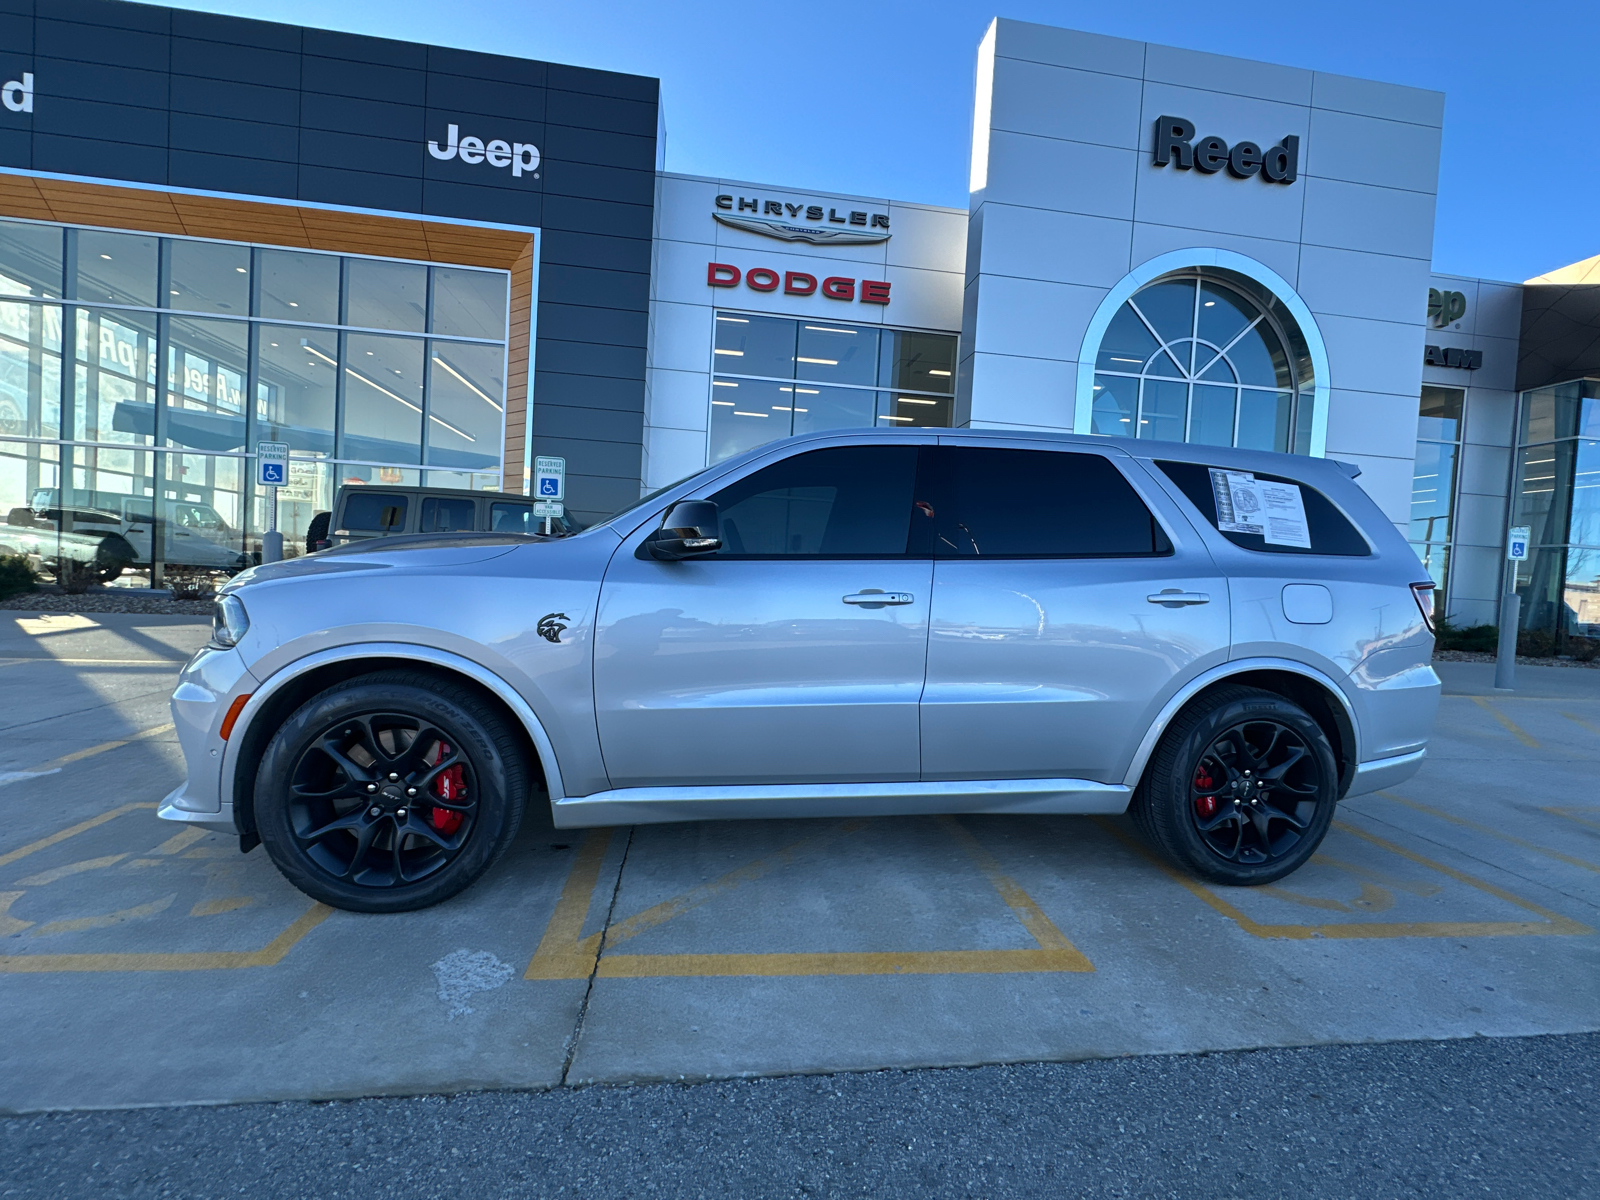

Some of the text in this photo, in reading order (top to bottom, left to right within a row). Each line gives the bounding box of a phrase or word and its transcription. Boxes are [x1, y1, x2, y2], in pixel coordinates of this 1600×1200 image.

[428, 124, 540, 177] Jeep
[1153, 115, 1299, 184] Reed
[715, 194, 890, 228] CHRYSLER
[707, 262, 891, 306] DODGE
[1427, 287, 1466, 328] ep
[1424, 345, 1483, 370] AM
[259, 453, 287, 461] PARKING
[260, 445, 287, 453] RESERVED
[538, 460, 562, 468] RESERVED
[538, 467, 562, 475] PARKING
